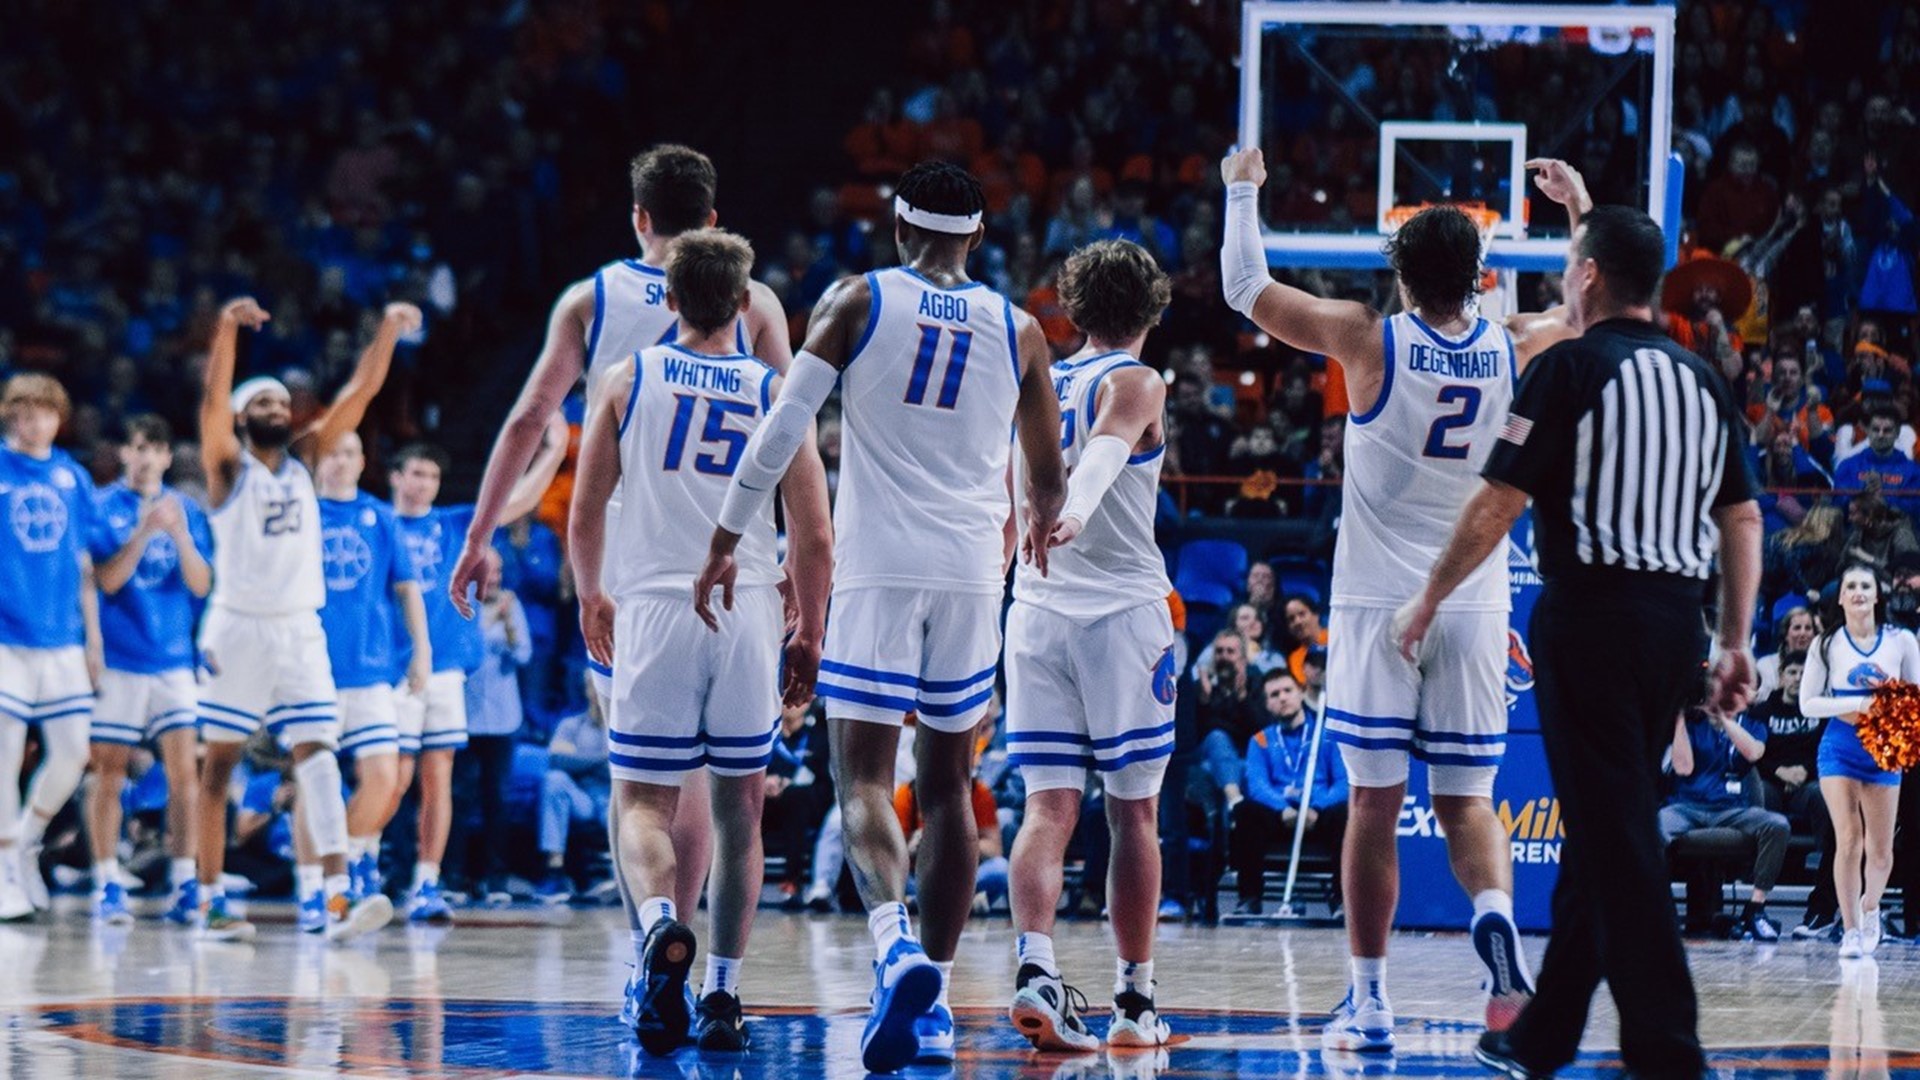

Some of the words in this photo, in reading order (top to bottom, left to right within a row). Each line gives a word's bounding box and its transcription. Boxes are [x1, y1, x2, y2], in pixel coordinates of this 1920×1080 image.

[919, 290, 968, 323] AGBO
[663, 357, 741, 393] WHITING
[903, 322, 973, 411] 11
[1409, 343, 1499, 379] DEGENHART
[663, 392, 758, 477] 15
[1422, 384, 1482, 460] 2
[1510, 841, 1562, 864] REN
